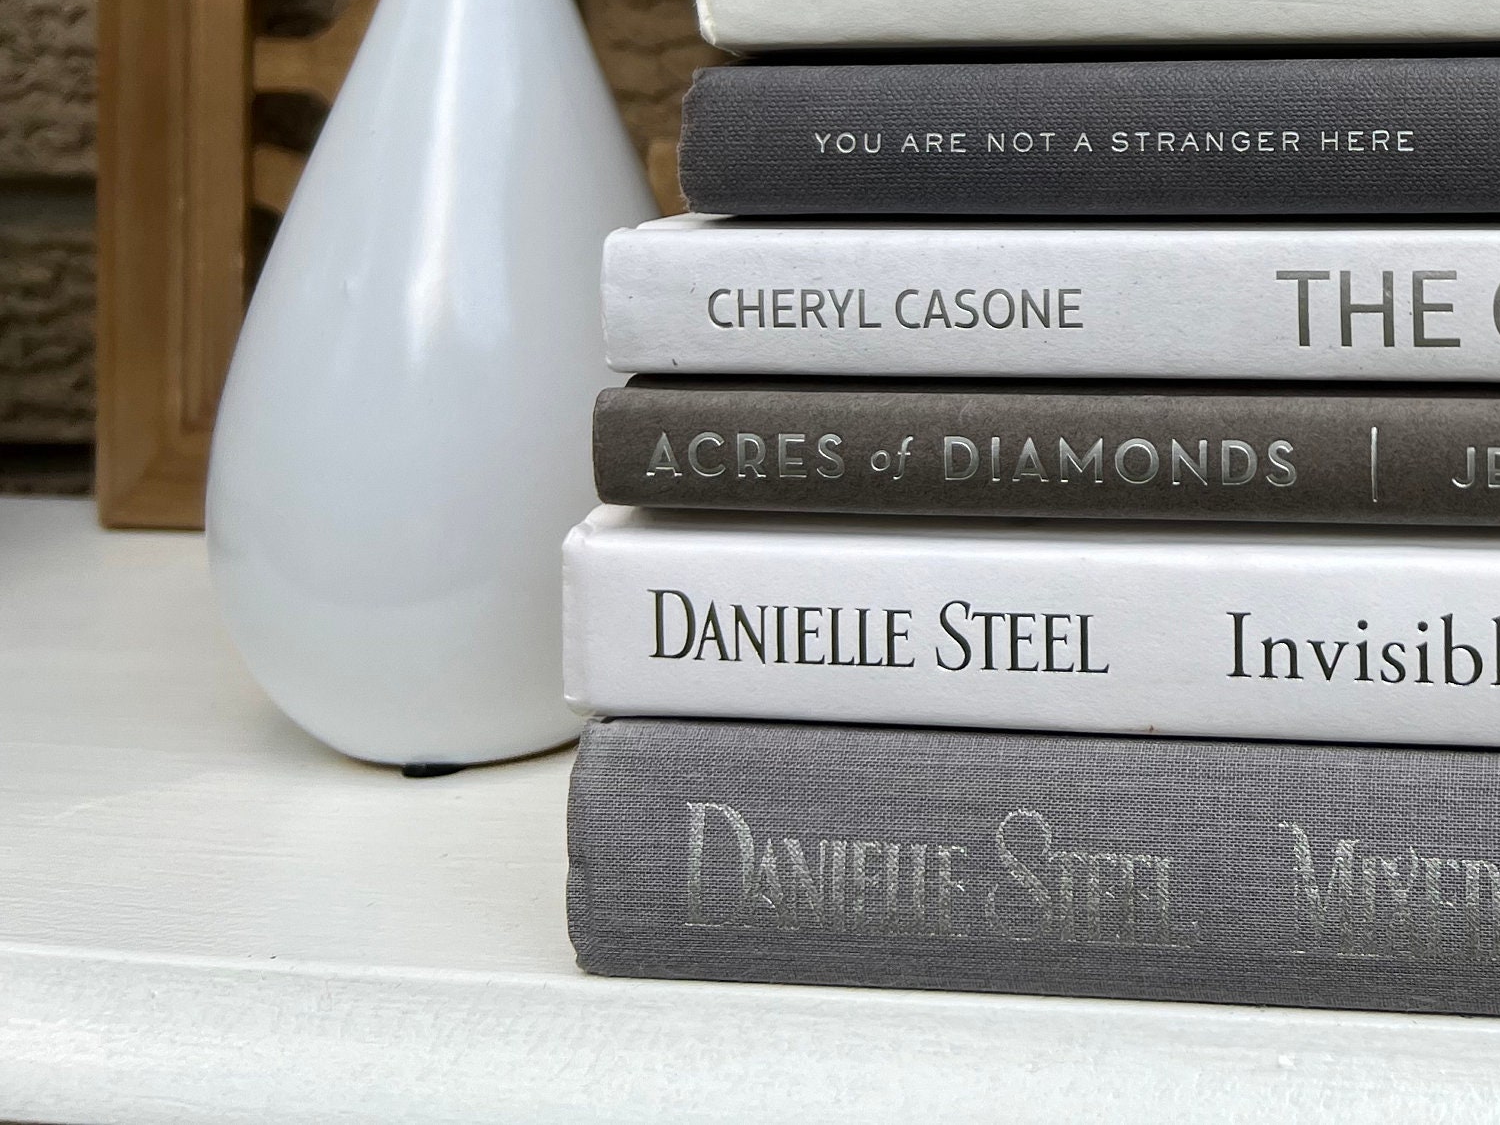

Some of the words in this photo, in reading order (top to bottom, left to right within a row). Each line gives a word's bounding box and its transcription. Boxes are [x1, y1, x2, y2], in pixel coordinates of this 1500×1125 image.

[814, 131, 883, 154] YOU
[901, 131, 967, 154] ARE
[987, 131, 1058, 153] NOT
[1073, 132, 1093, 152] A
[1110, 130, 1301, 153] STRANGER
[1320, 129, 1416, 153] HERE
[706, 288, 882, 330] CHERYL
[895, 288, 1085, 330] CASONE
[1275, 269, 1461, 349] THE
[645, 431, 844, 481] ACRES
[870, 435, 912, 481] of
[942, 435, 1298, 488] DIAMONDS
[648, 589, 915, 669] DANIELLE
[936, 600, 1110, 675] STEEL
